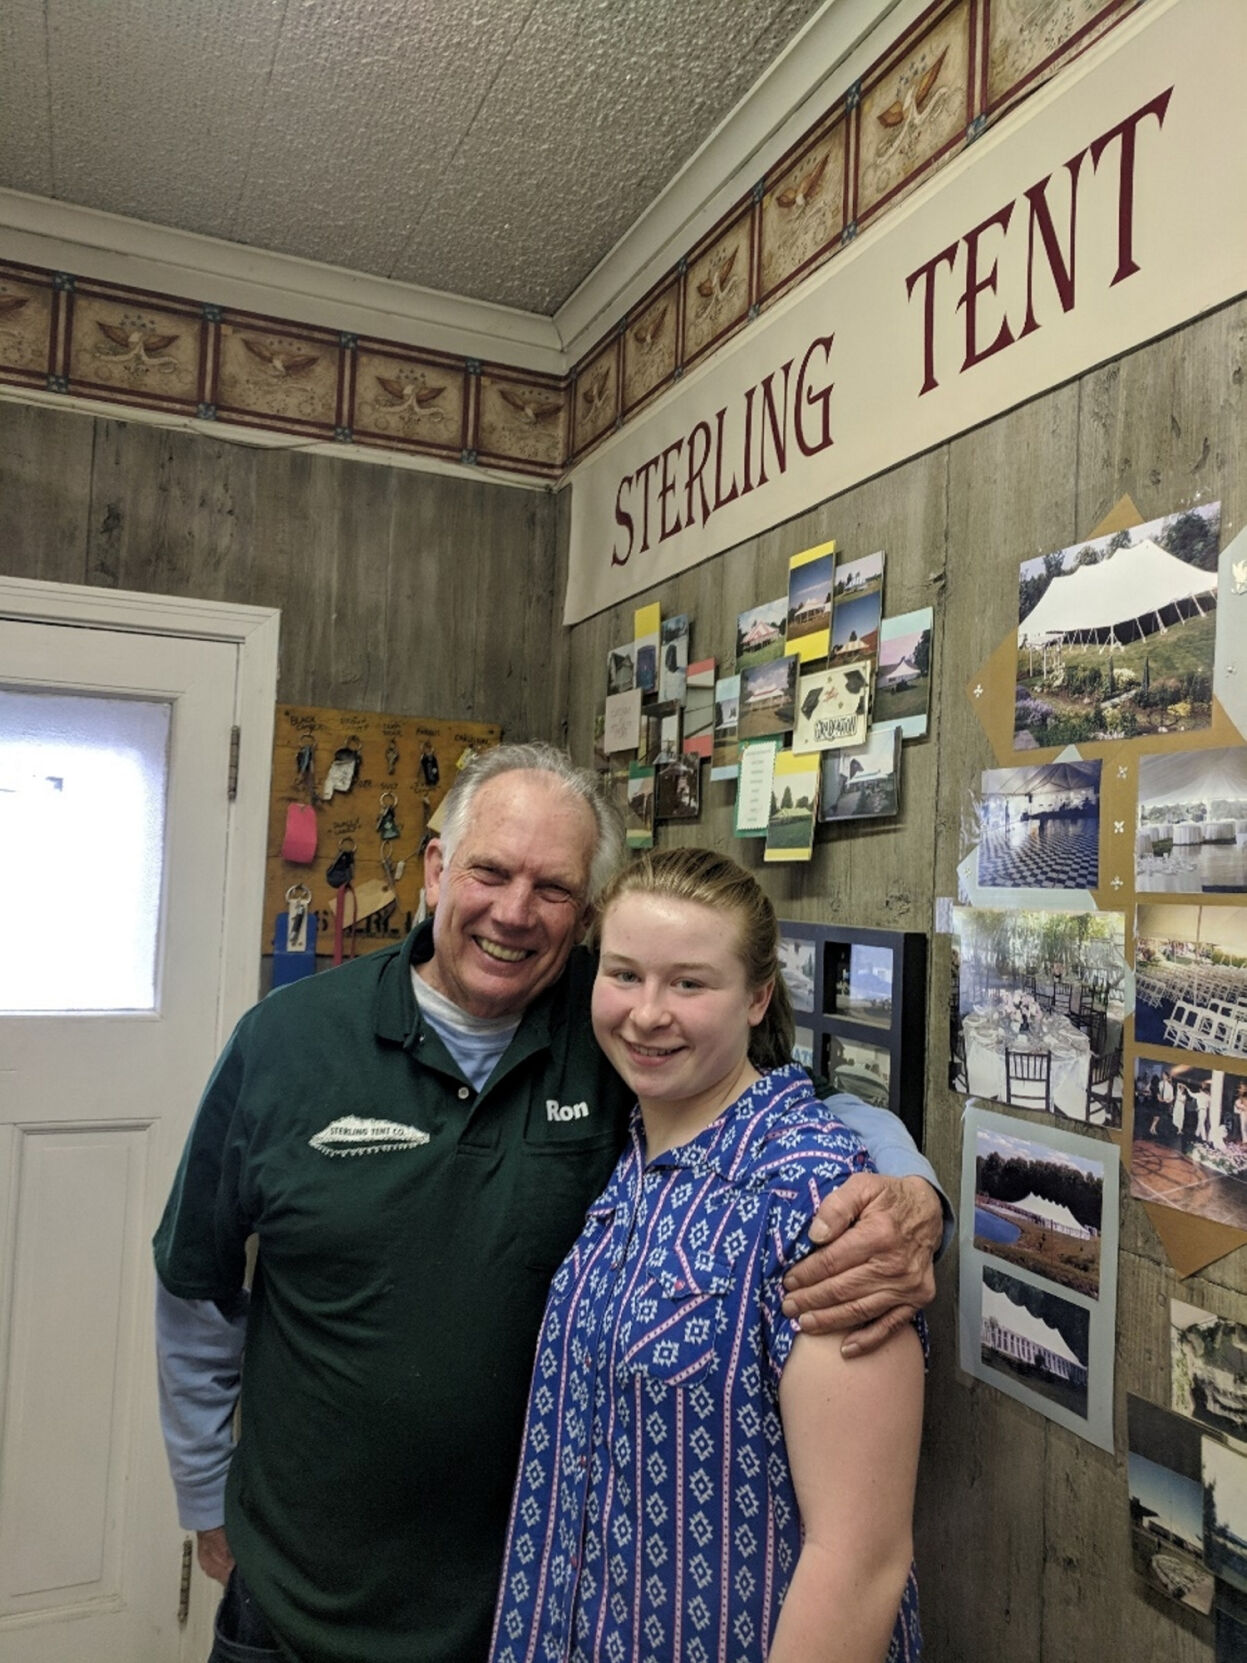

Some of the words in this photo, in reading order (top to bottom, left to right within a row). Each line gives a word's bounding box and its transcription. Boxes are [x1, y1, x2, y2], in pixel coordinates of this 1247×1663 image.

[610, 331, 835, 568] STERLING
[905, 85, 1174, 397] TENT
[546, 1099, 589, 1121] Ron
[330, 1126, 368, 1136] STERLING
[370, 1126, 391, 1136] TENT
